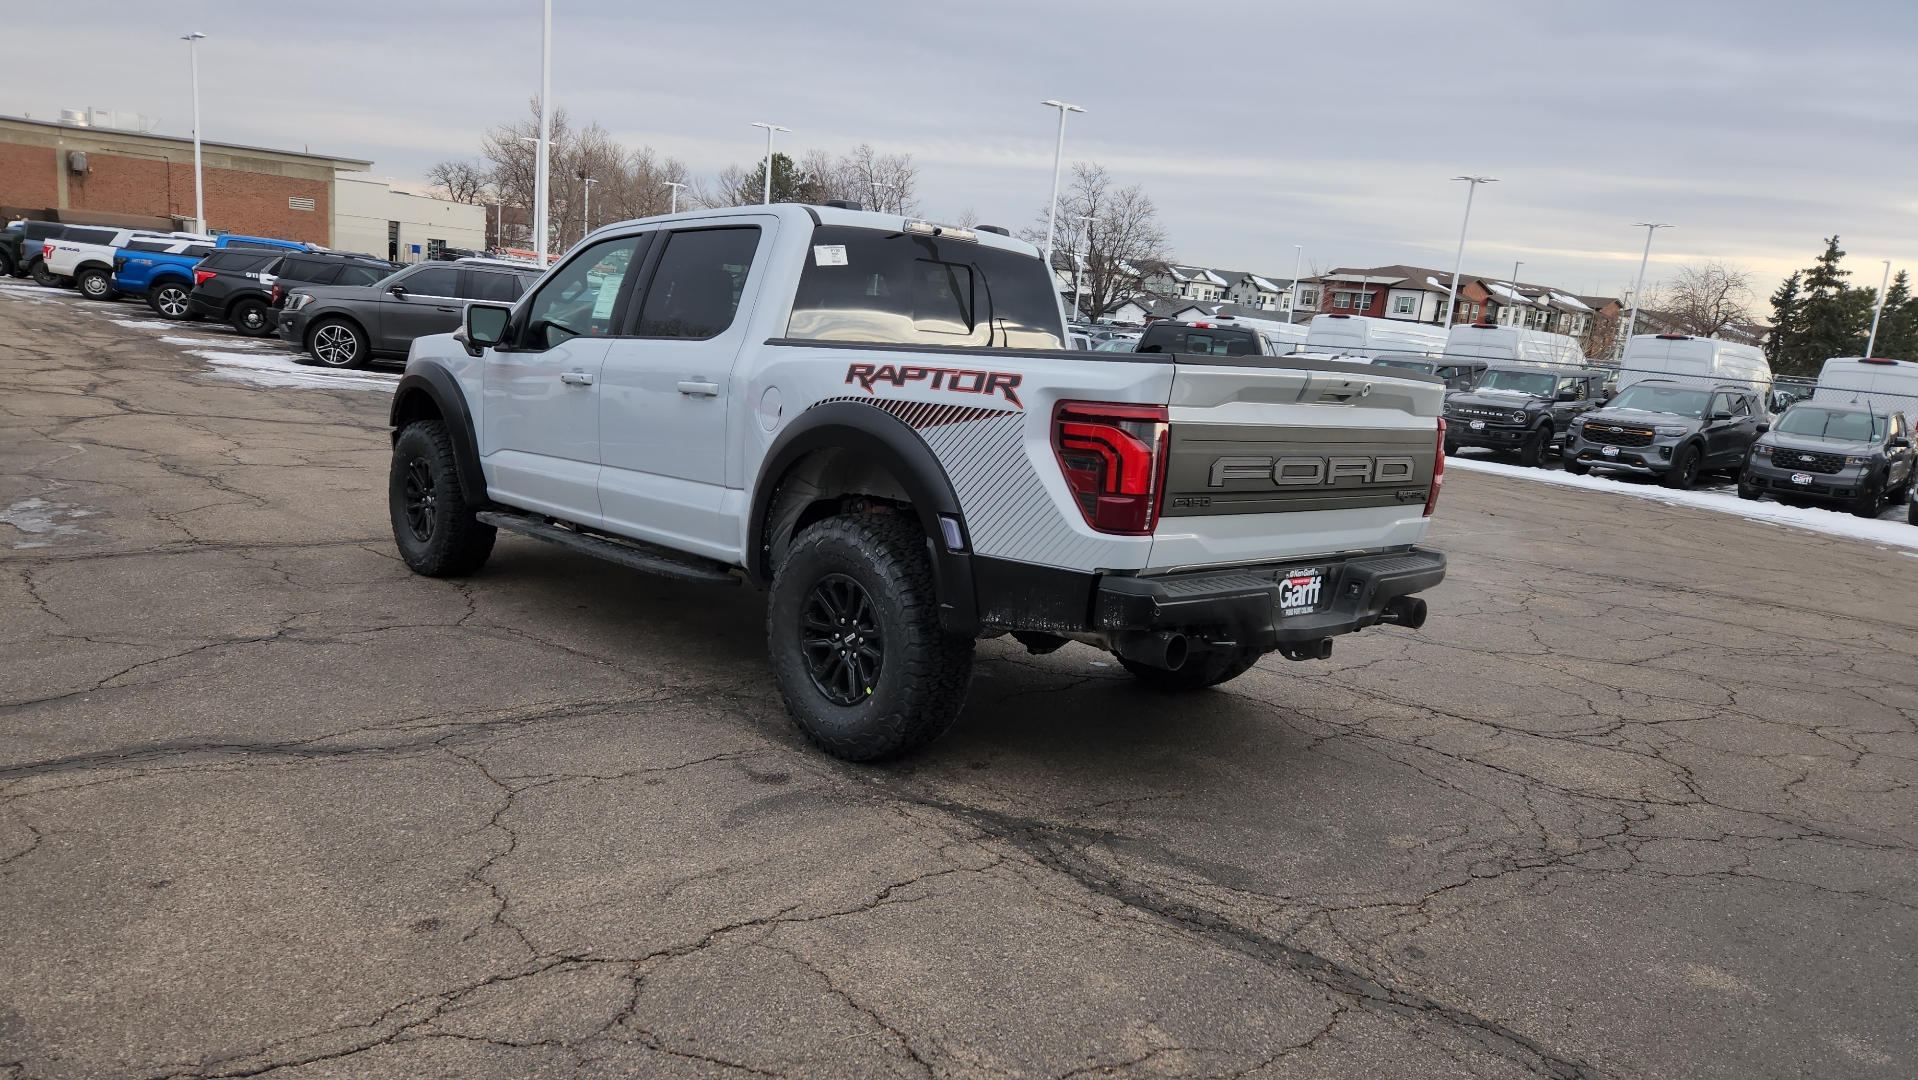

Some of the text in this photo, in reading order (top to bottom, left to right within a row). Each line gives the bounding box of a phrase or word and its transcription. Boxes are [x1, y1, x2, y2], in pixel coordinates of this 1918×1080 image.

[845, 363, 1023, 410] RAPTOR
[1459, 409, 1503, 417] BRONCO
[1207, 456, 1416, 487] FORD
[1279, 576, 1321, 608] Garff
